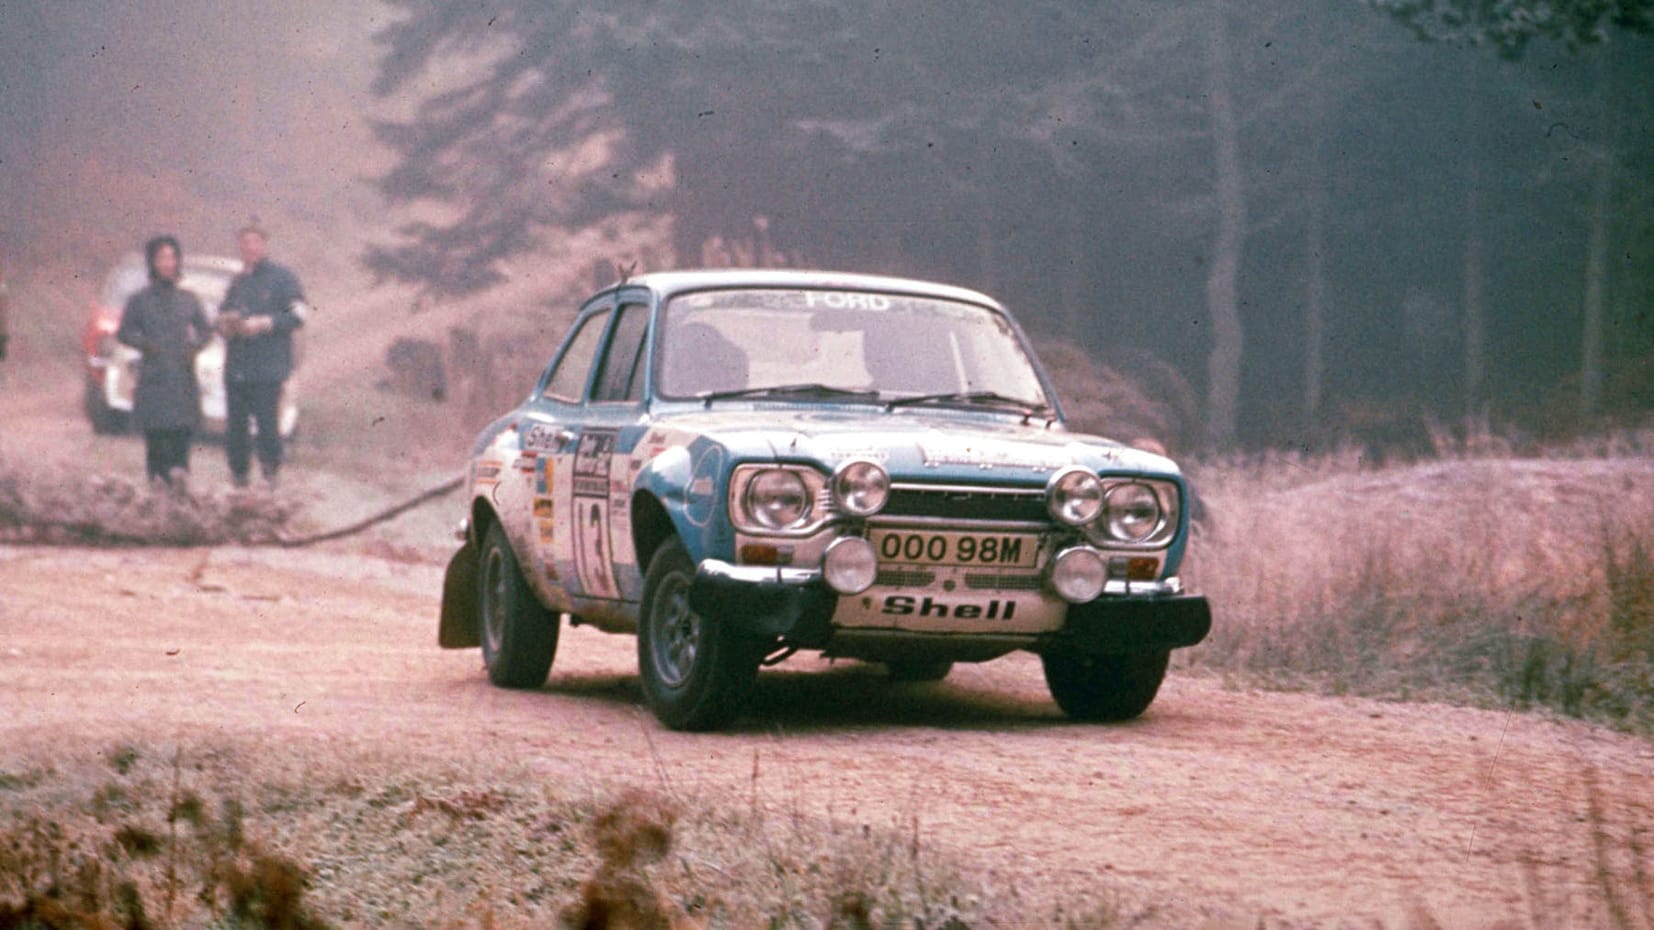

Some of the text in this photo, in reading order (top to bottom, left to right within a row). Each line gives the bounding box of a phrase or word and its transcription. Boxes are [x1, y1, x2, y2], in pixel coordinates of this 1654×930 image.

[805, 291, 890, 311] FORD
[956, 535, 1022, 564] 98M
[881, 595, 1017, 621] Shell
